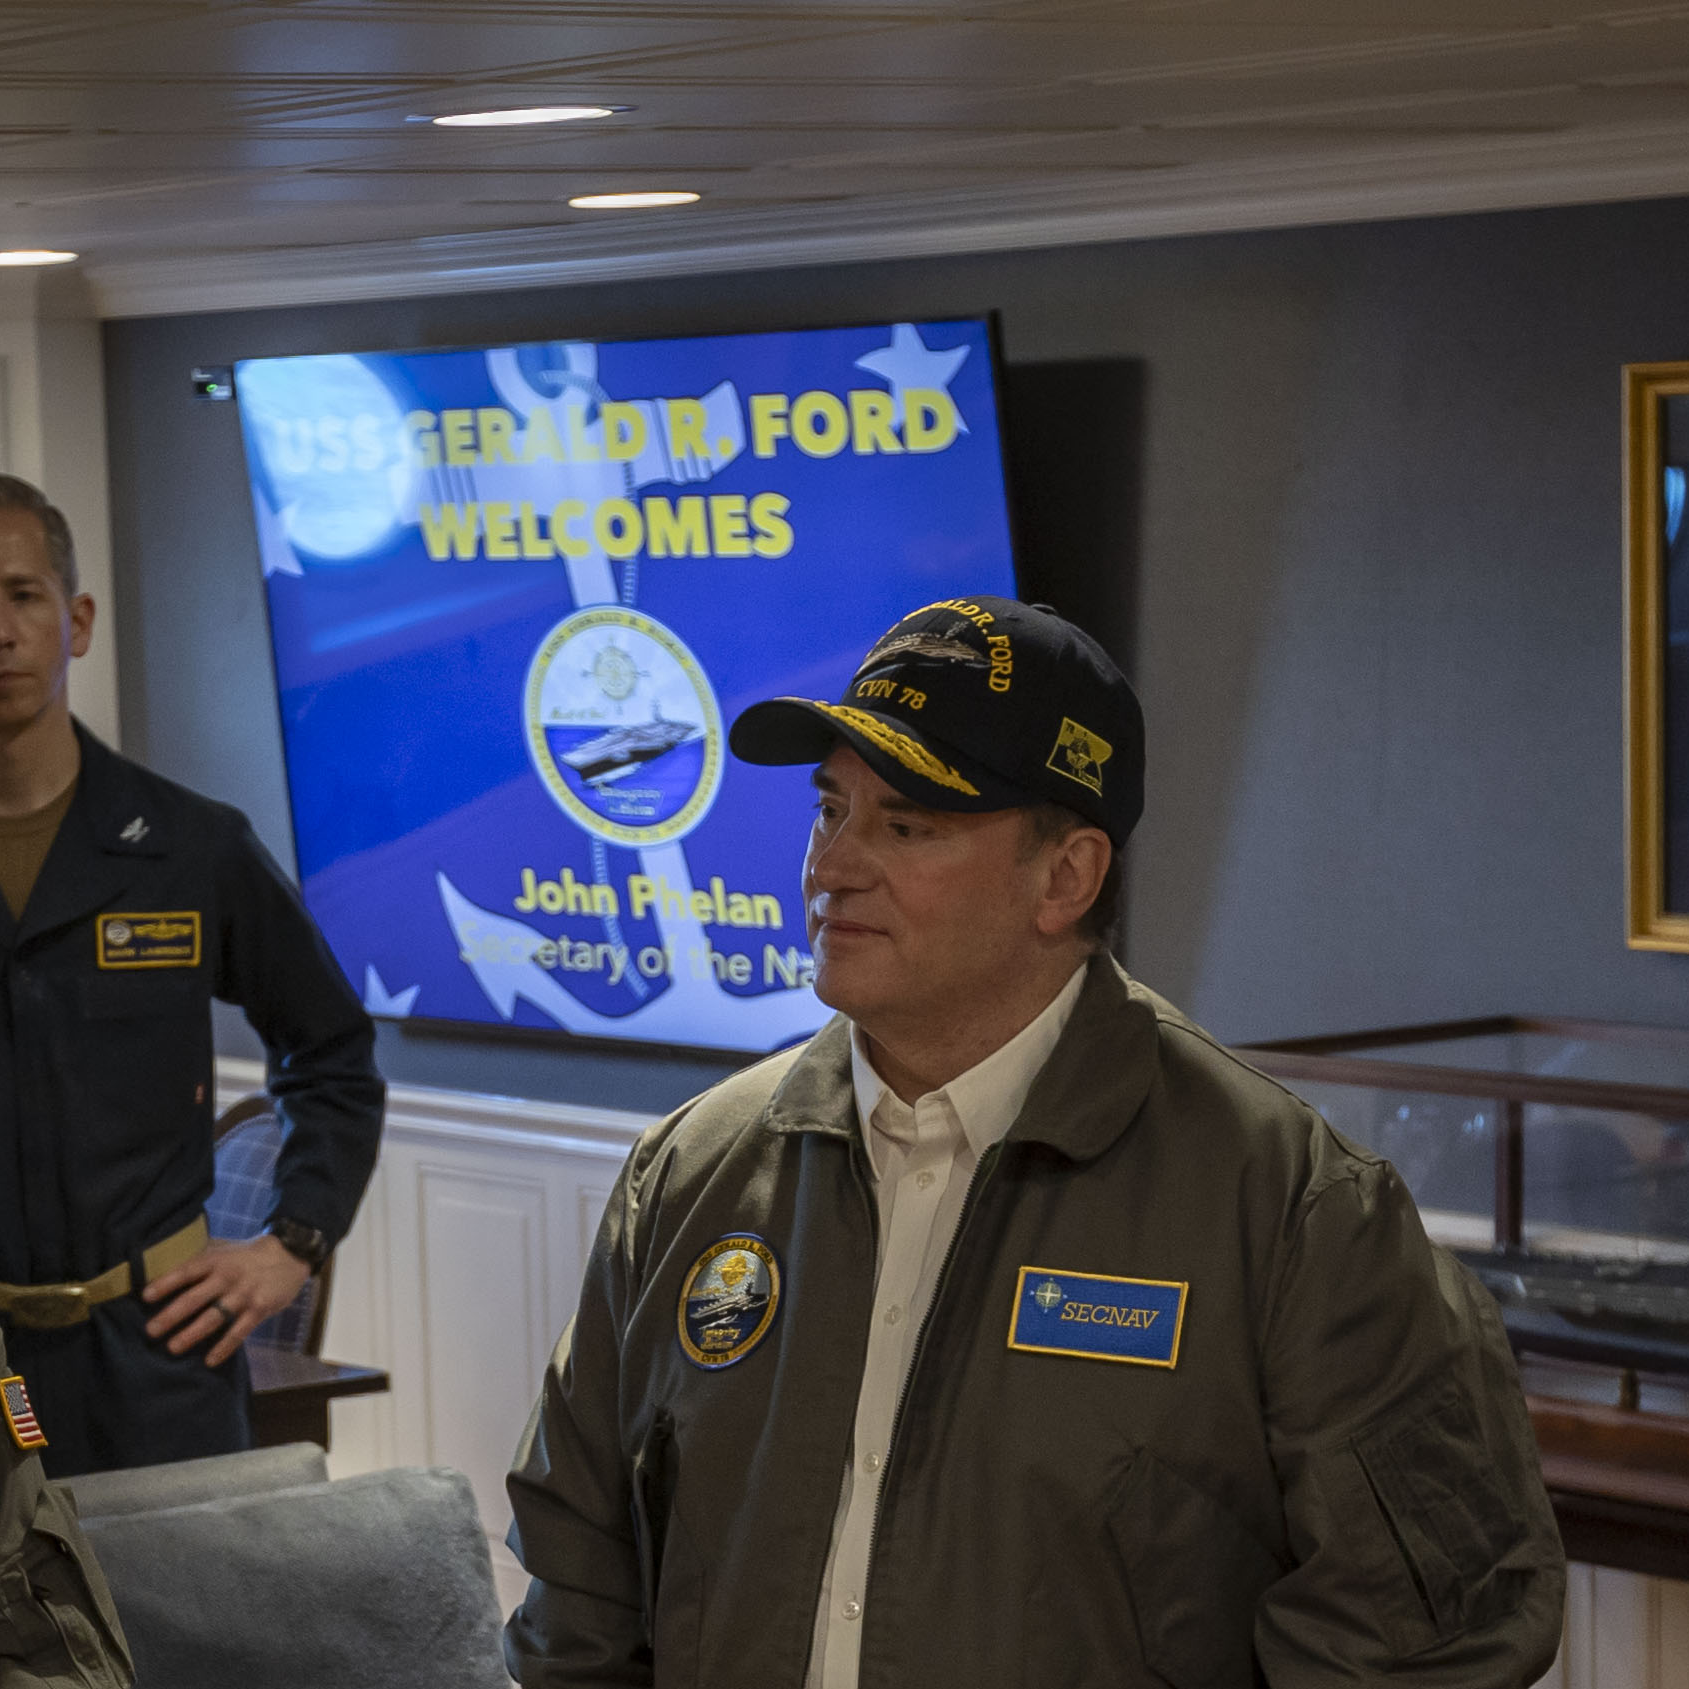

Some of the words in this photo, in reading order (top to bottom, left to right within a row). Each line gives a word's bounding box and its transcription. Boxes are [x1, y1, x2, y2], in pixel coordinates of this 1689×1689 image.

[276, 411, 397, 474] USS
[405, 403, 648, 468] GERALD
[672, 400, 737, 462] R.
[750, 390, 961, 458] FORD
[421, 494, 795, 562] WELCOMES
[987, 634, 1012, 692] FORD
[856, 679, 896, 700] CVN
[903, 688, 927, 710] 78
[514, 869, 618, 918] John
[630, 877, 783, 930] Phelan
[458, 922, 629, 985] Secretary
[637, 936, 676, 975] of
[687, 941, 748, 982] the
[1060, 1301, 1160, 1330] SECNAV
